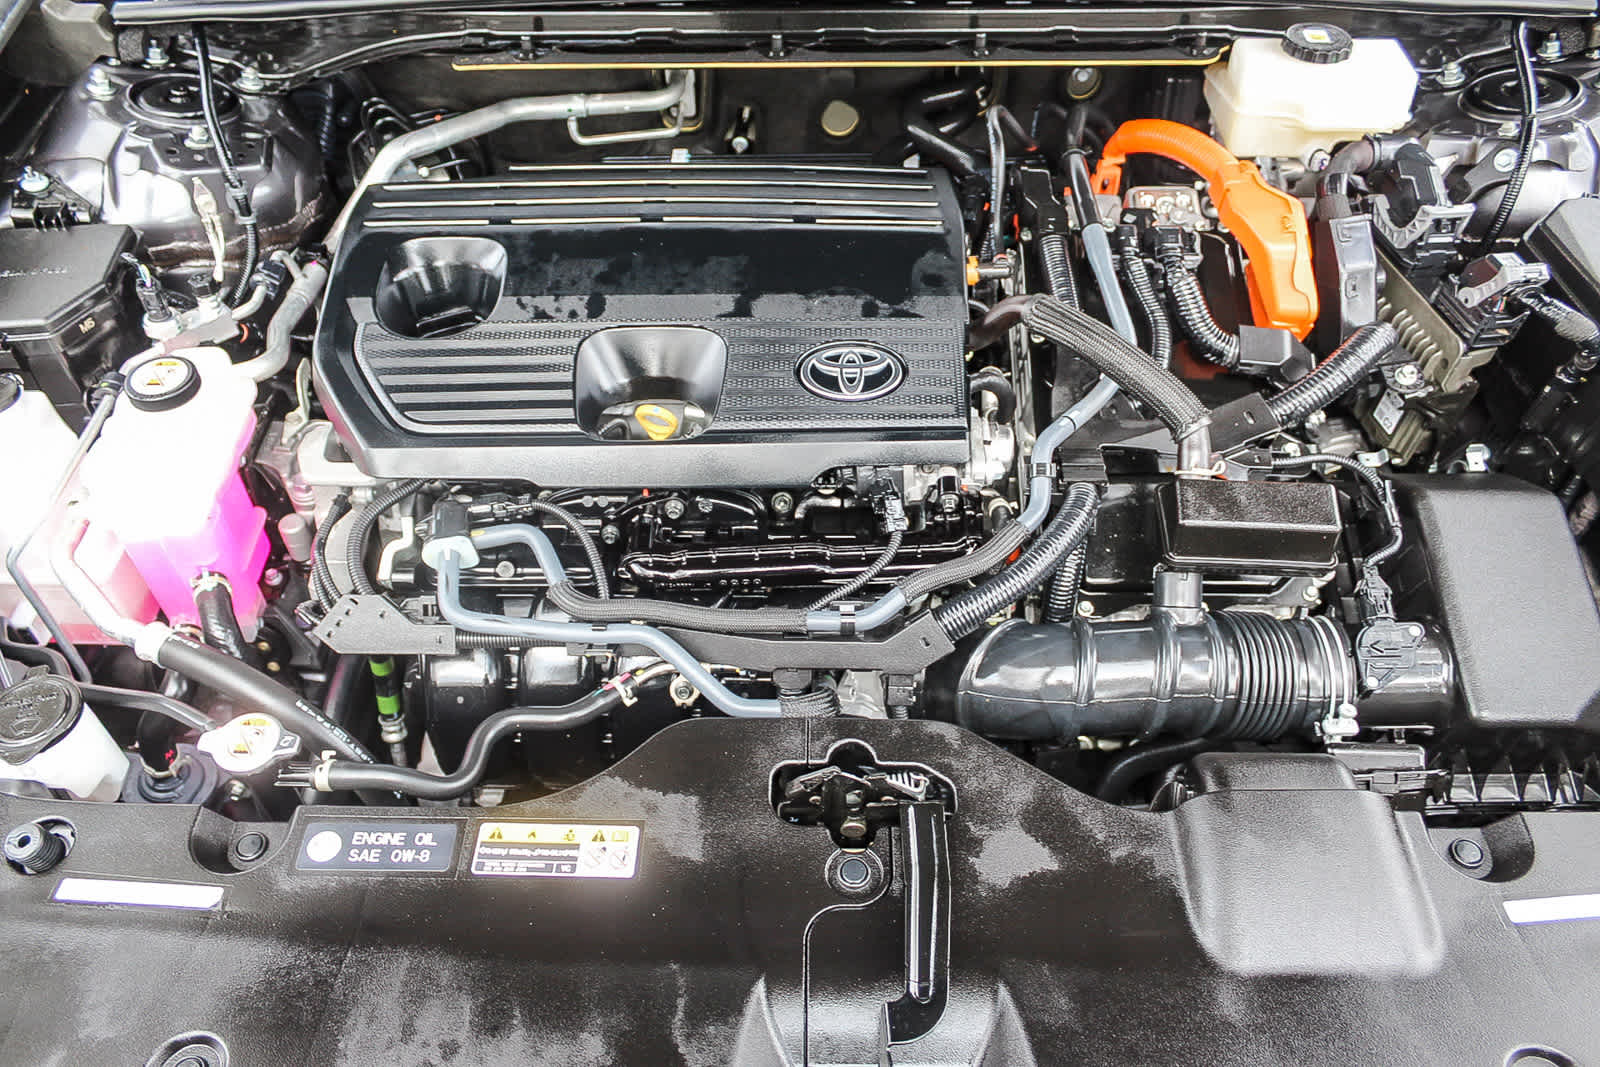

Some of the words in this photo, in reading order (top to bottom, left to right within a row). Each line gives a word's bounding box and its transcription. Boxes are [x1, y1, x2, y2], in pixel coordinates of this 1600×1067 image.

[351, 831, 407, 846] ENGINE
[414, 832, 438, 847] OIL
[347, 848, 382, 863] SAE
